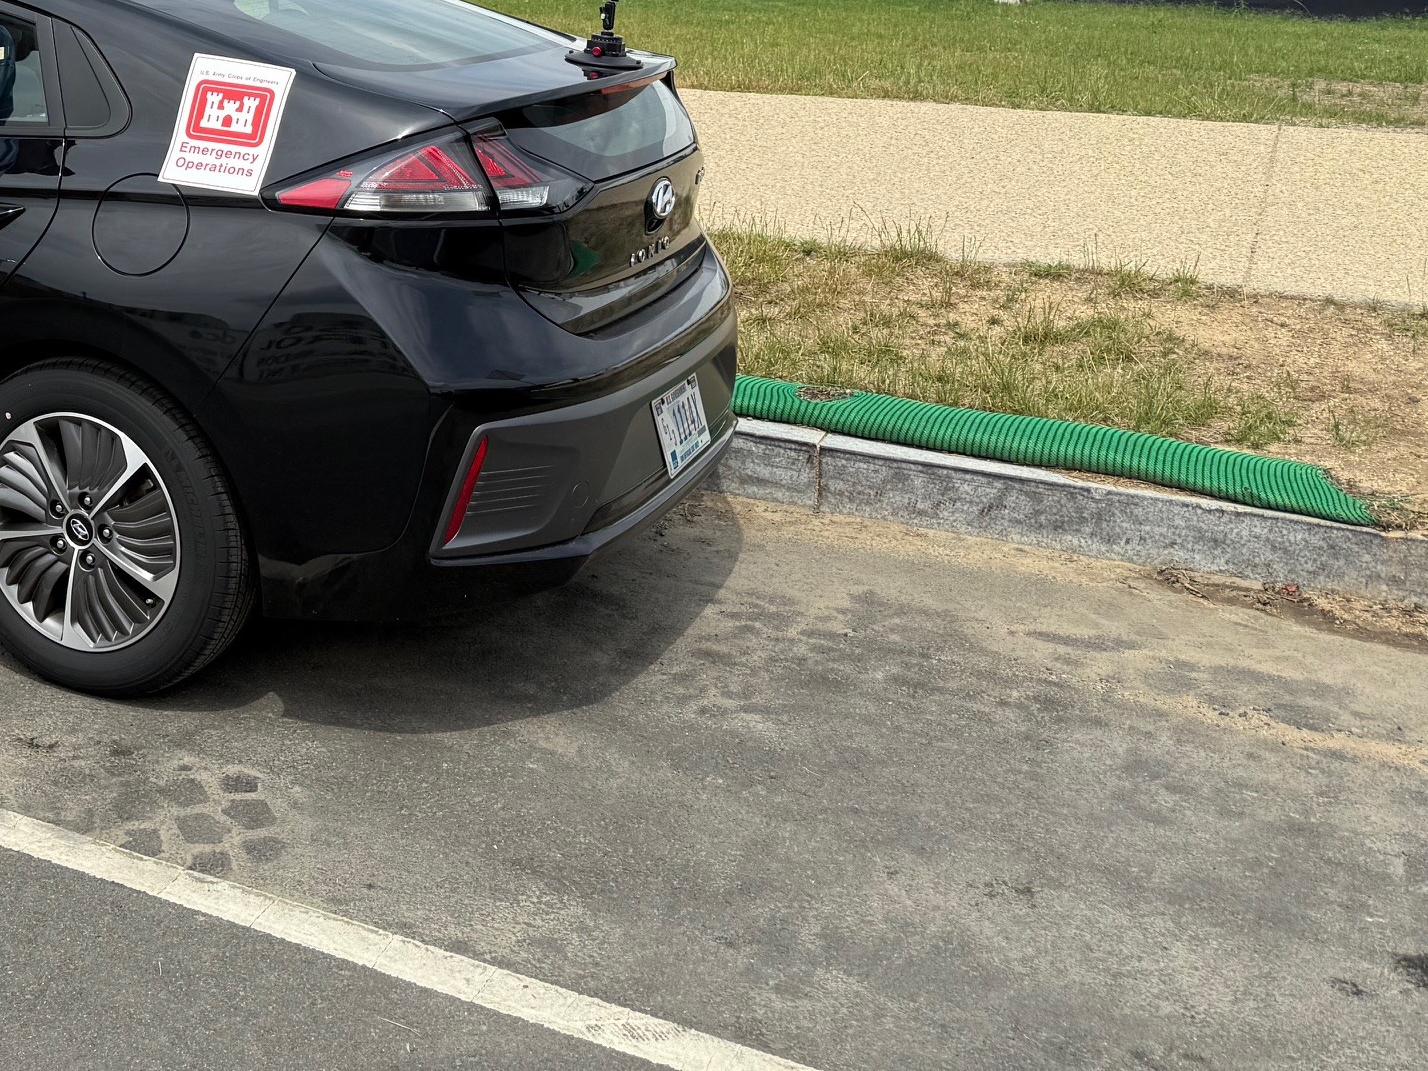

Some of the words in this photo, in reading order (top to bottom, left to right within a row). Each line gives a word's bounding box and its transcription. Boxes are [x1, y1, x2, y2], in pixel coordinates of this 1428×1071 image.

[253, 76, 279, 85] Engineers
[179, 142, 259, 164] Emergency
[175, 157, 254, 177] Operations
